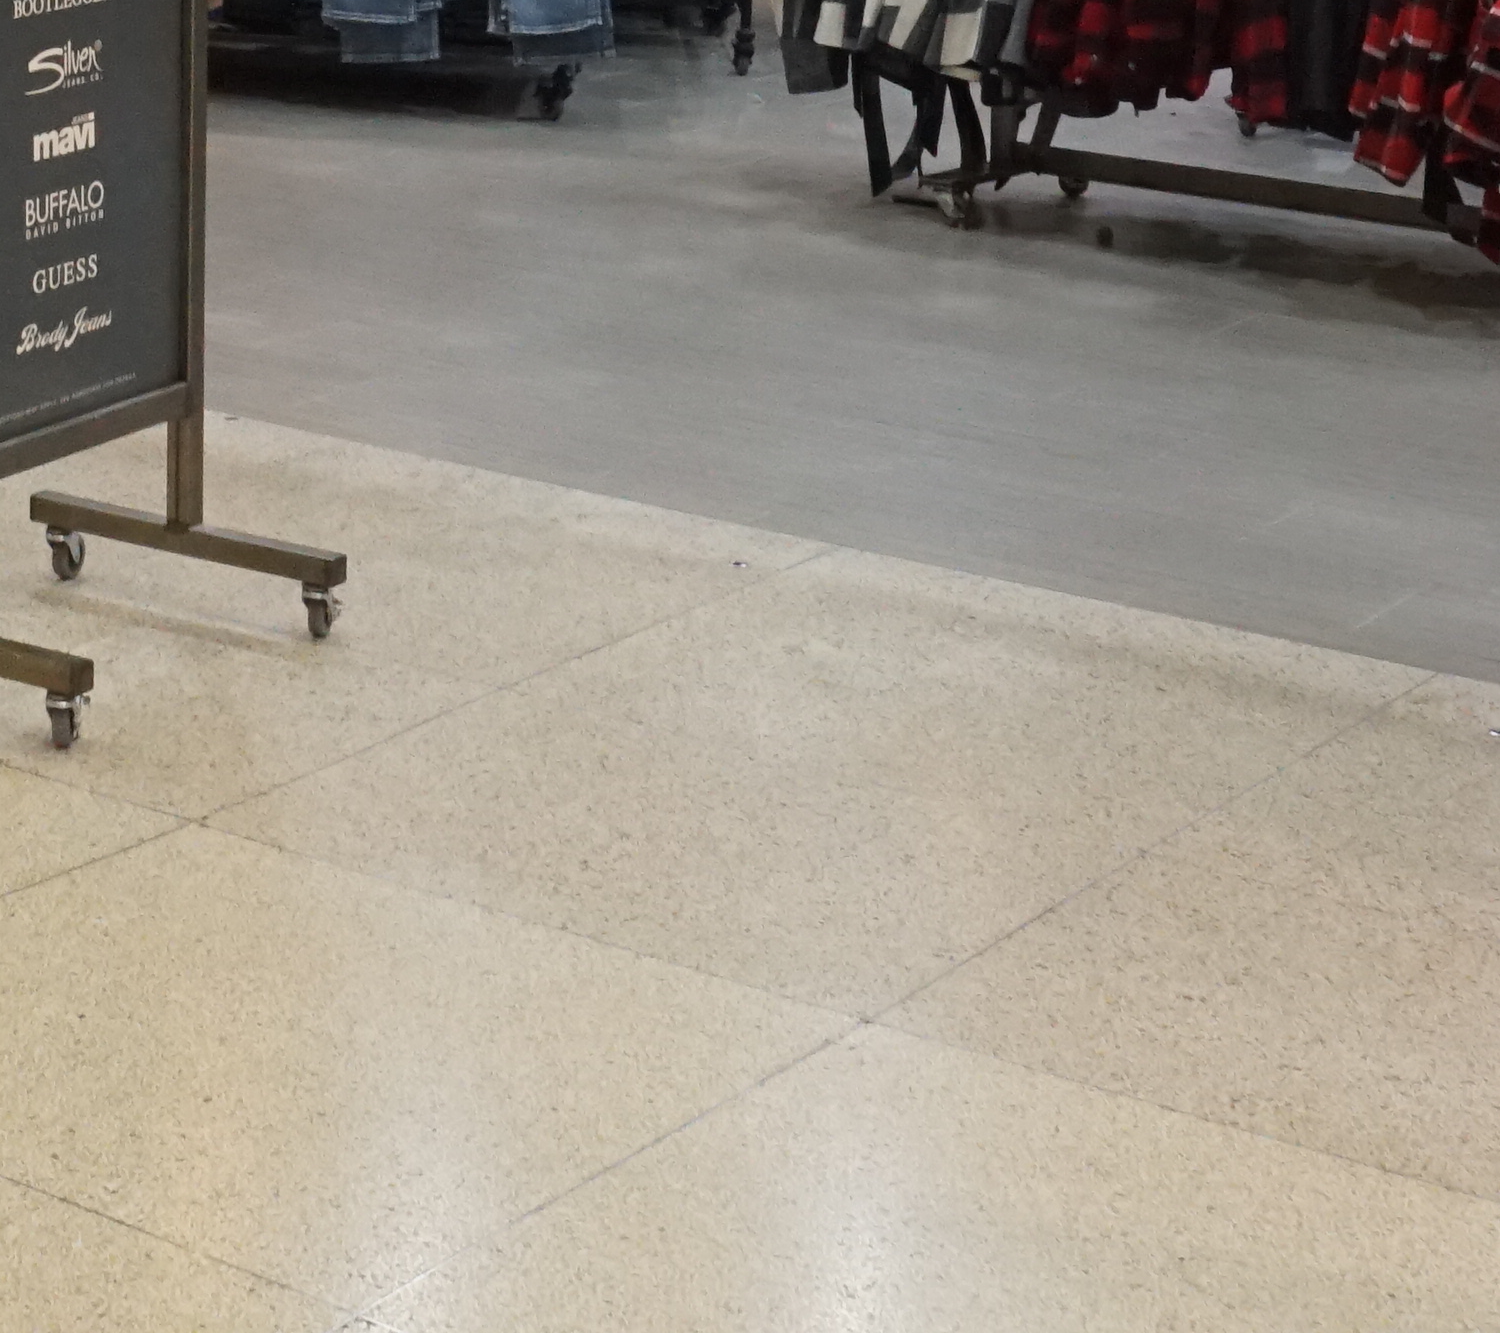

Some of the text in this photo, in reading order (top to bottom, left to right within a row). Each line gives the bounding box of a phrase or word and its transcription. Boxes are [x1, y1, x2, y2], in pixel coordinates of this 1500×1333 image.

[33, 112, 95, 162] mavi
[25, 180, 104, 227] BUFFALO
[25, 222, 58, 240] DAVID
[33, 253, 98, 294] GUESS
[16, 306, 112, 355] Brody Jeans
